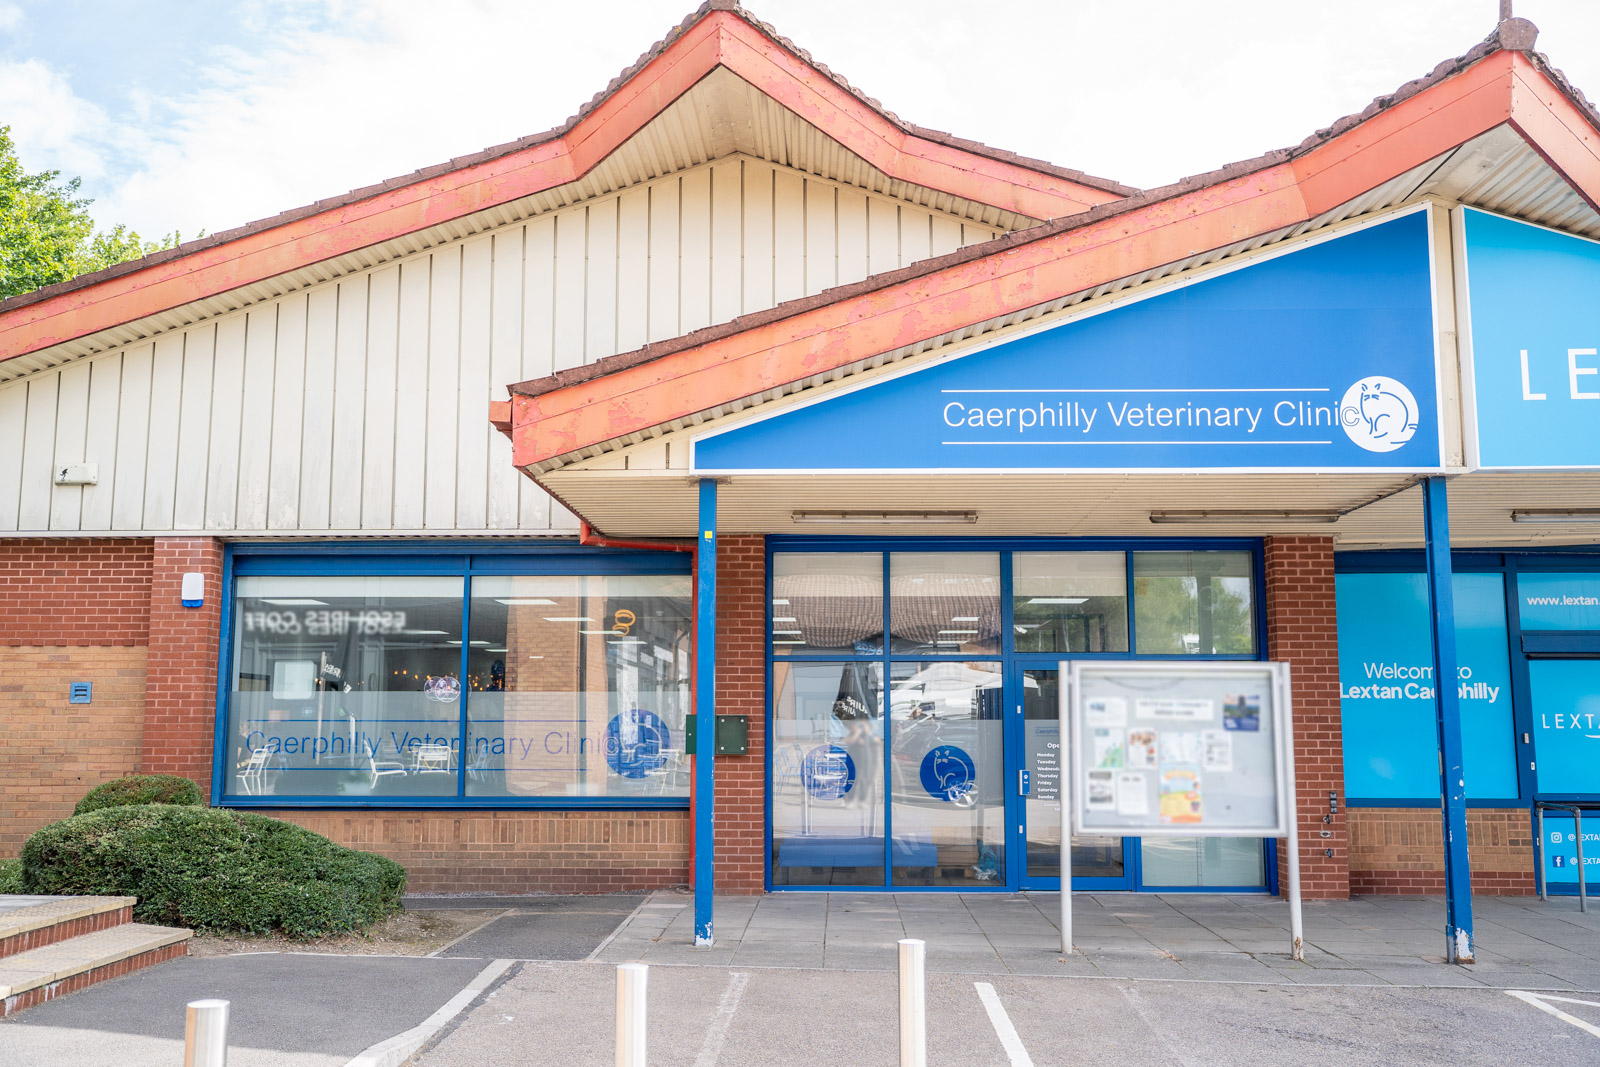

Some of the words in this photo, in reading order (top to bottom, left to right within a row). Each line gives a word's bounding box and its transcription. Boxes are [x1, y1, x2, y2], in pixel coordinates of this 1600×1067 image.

[943, 401, 1097, 433] Caerphilly
[1107, 401, 1262, 433] Veterinary
[1273, 400, 1360, 427] Clinic
[1363, 662, 1434, 680] Welcom
[1340, 682, 1403, 700] Lextan
[1404, 682, 1500, 704] Cahilly
[1541, 713, 1600, 730] LEXT
[246, 731, 382, 760] Caerphilly
[391, 732, 534, 760] Veterinary
[544, 731, 619, 755] Clinic
